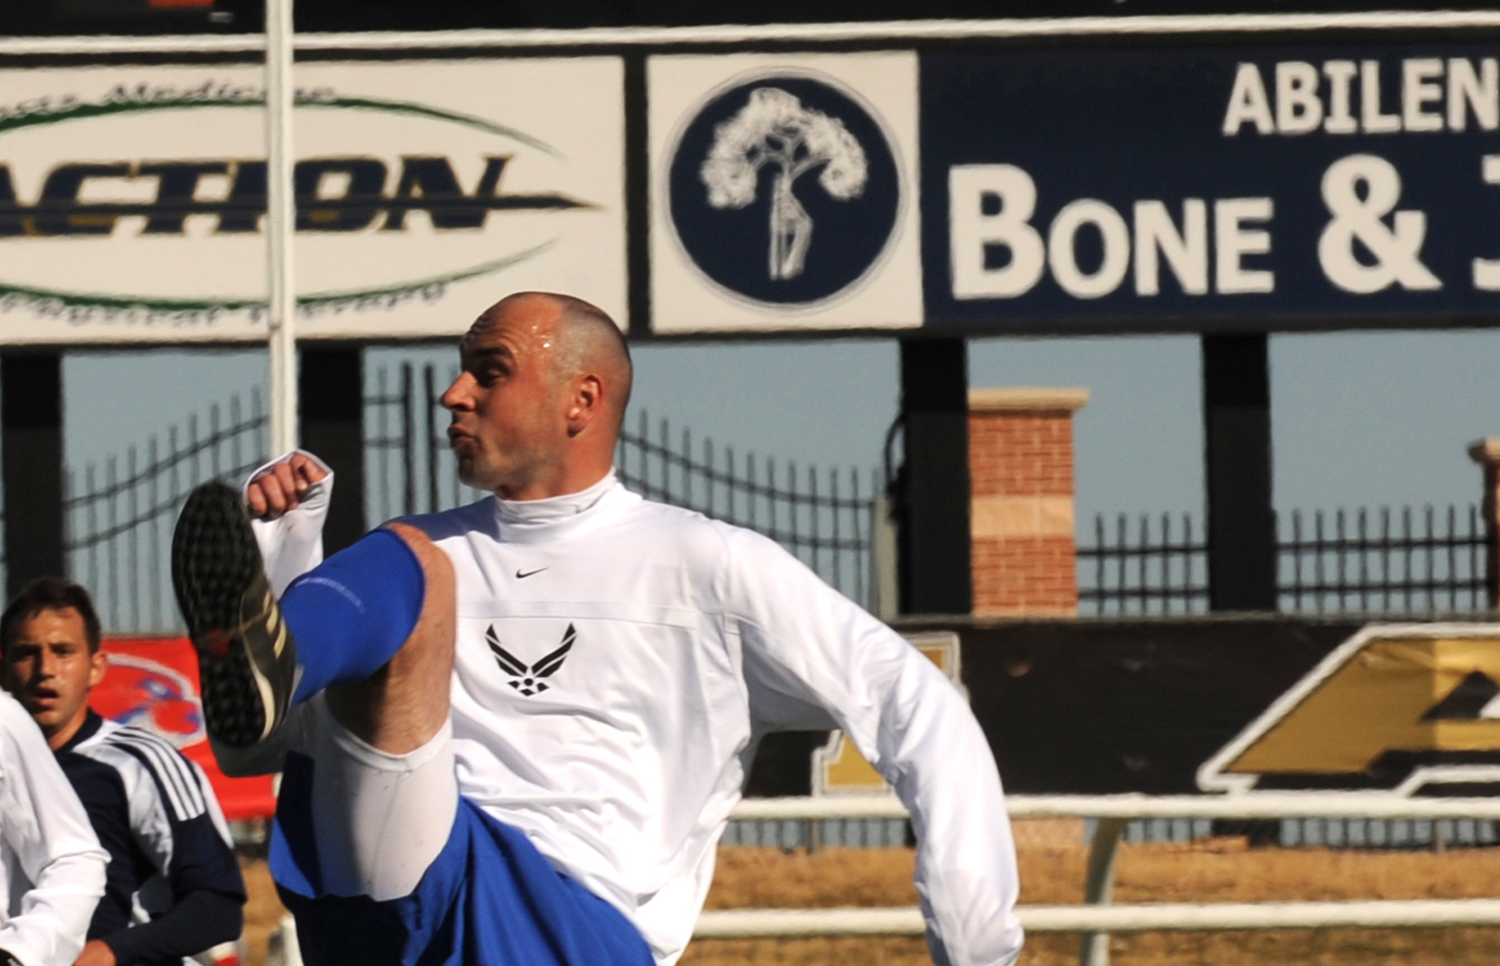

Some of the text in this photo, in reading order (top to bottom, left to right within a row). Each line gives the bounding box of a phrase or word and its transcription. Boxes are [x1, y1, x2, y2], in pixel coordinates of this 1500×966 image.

[100, 80, 334, 104] Medice
[1222, 57, 1500, 136] ABILEN
[1317, 153, 1443, 294] &
[244, 279, 446, 325] Terapy
